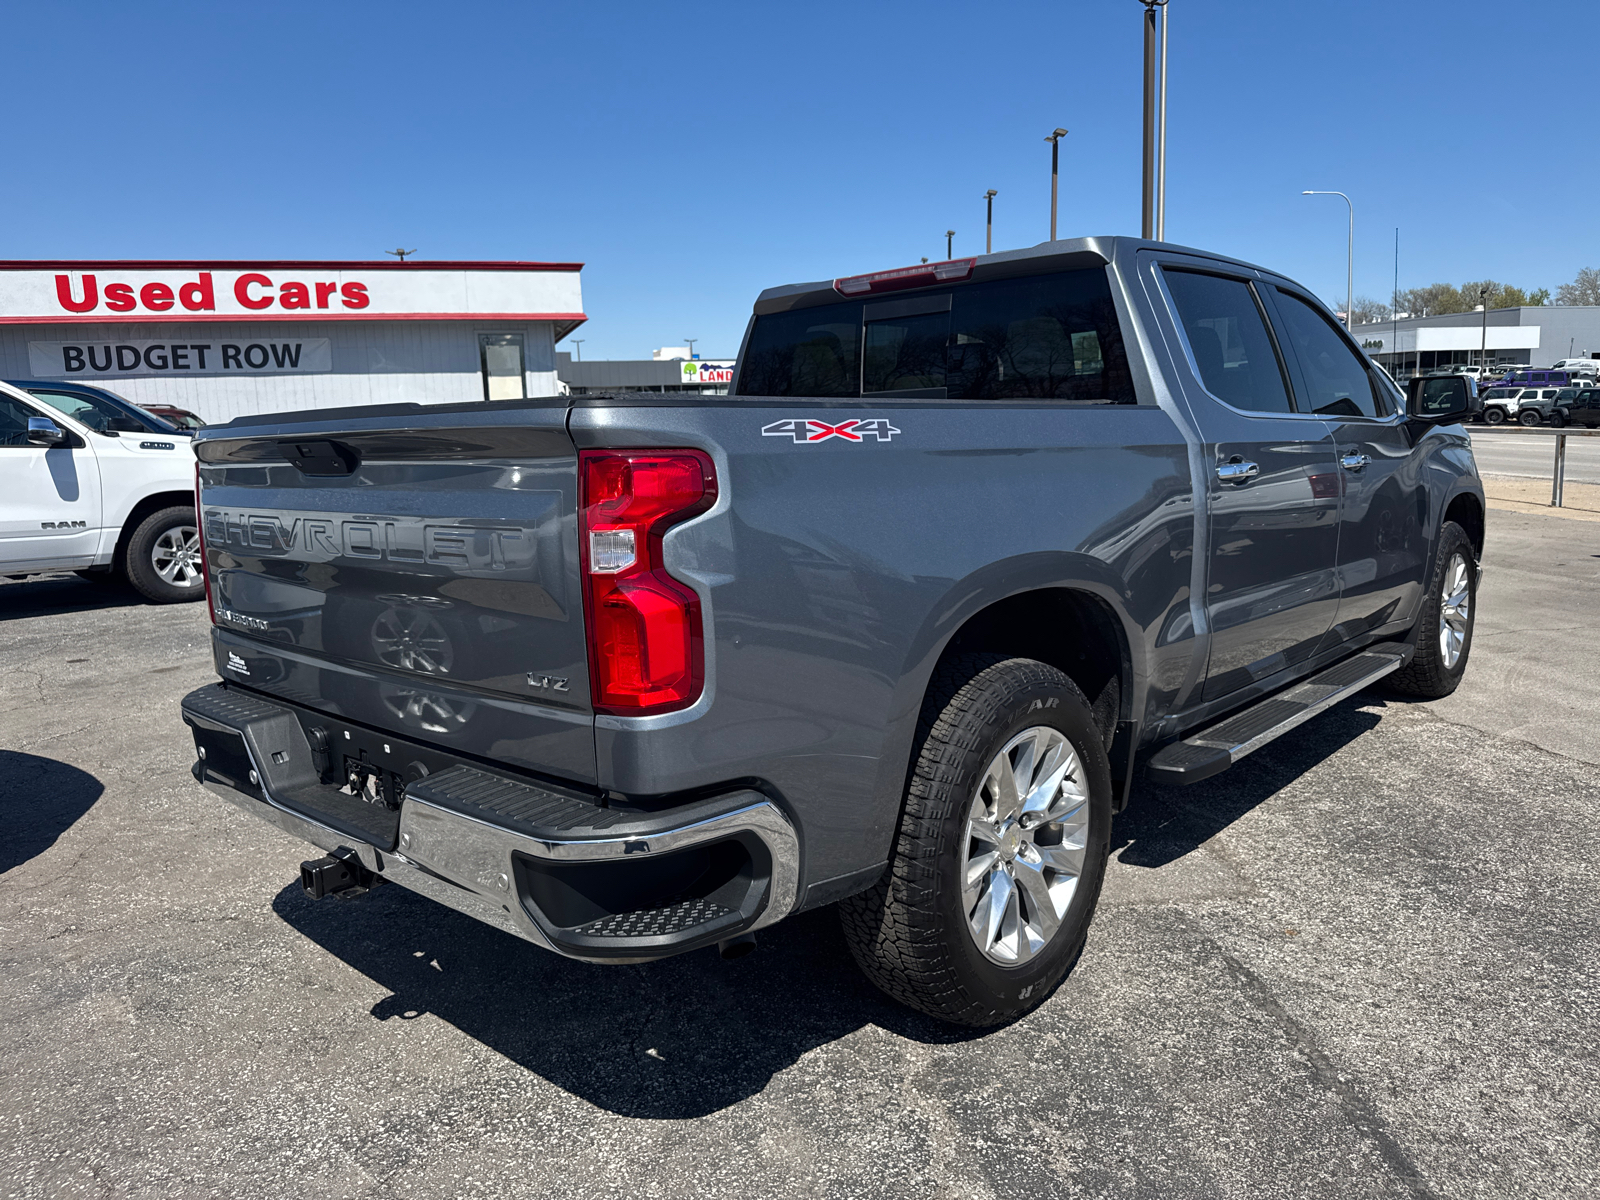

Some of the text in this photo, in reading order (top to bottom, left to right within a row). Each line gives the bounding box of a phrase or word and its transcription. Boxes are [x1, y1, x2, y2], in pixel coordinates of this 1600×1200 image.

[55, 272, 370, 313] Used Cars
[63, 343, 303, 373] BUDGET ROW
[41, 520, 87, 530] RAM
[204, 510, 524, 571] CHEVROLET
[527, 671, 570, 692] LTZ
